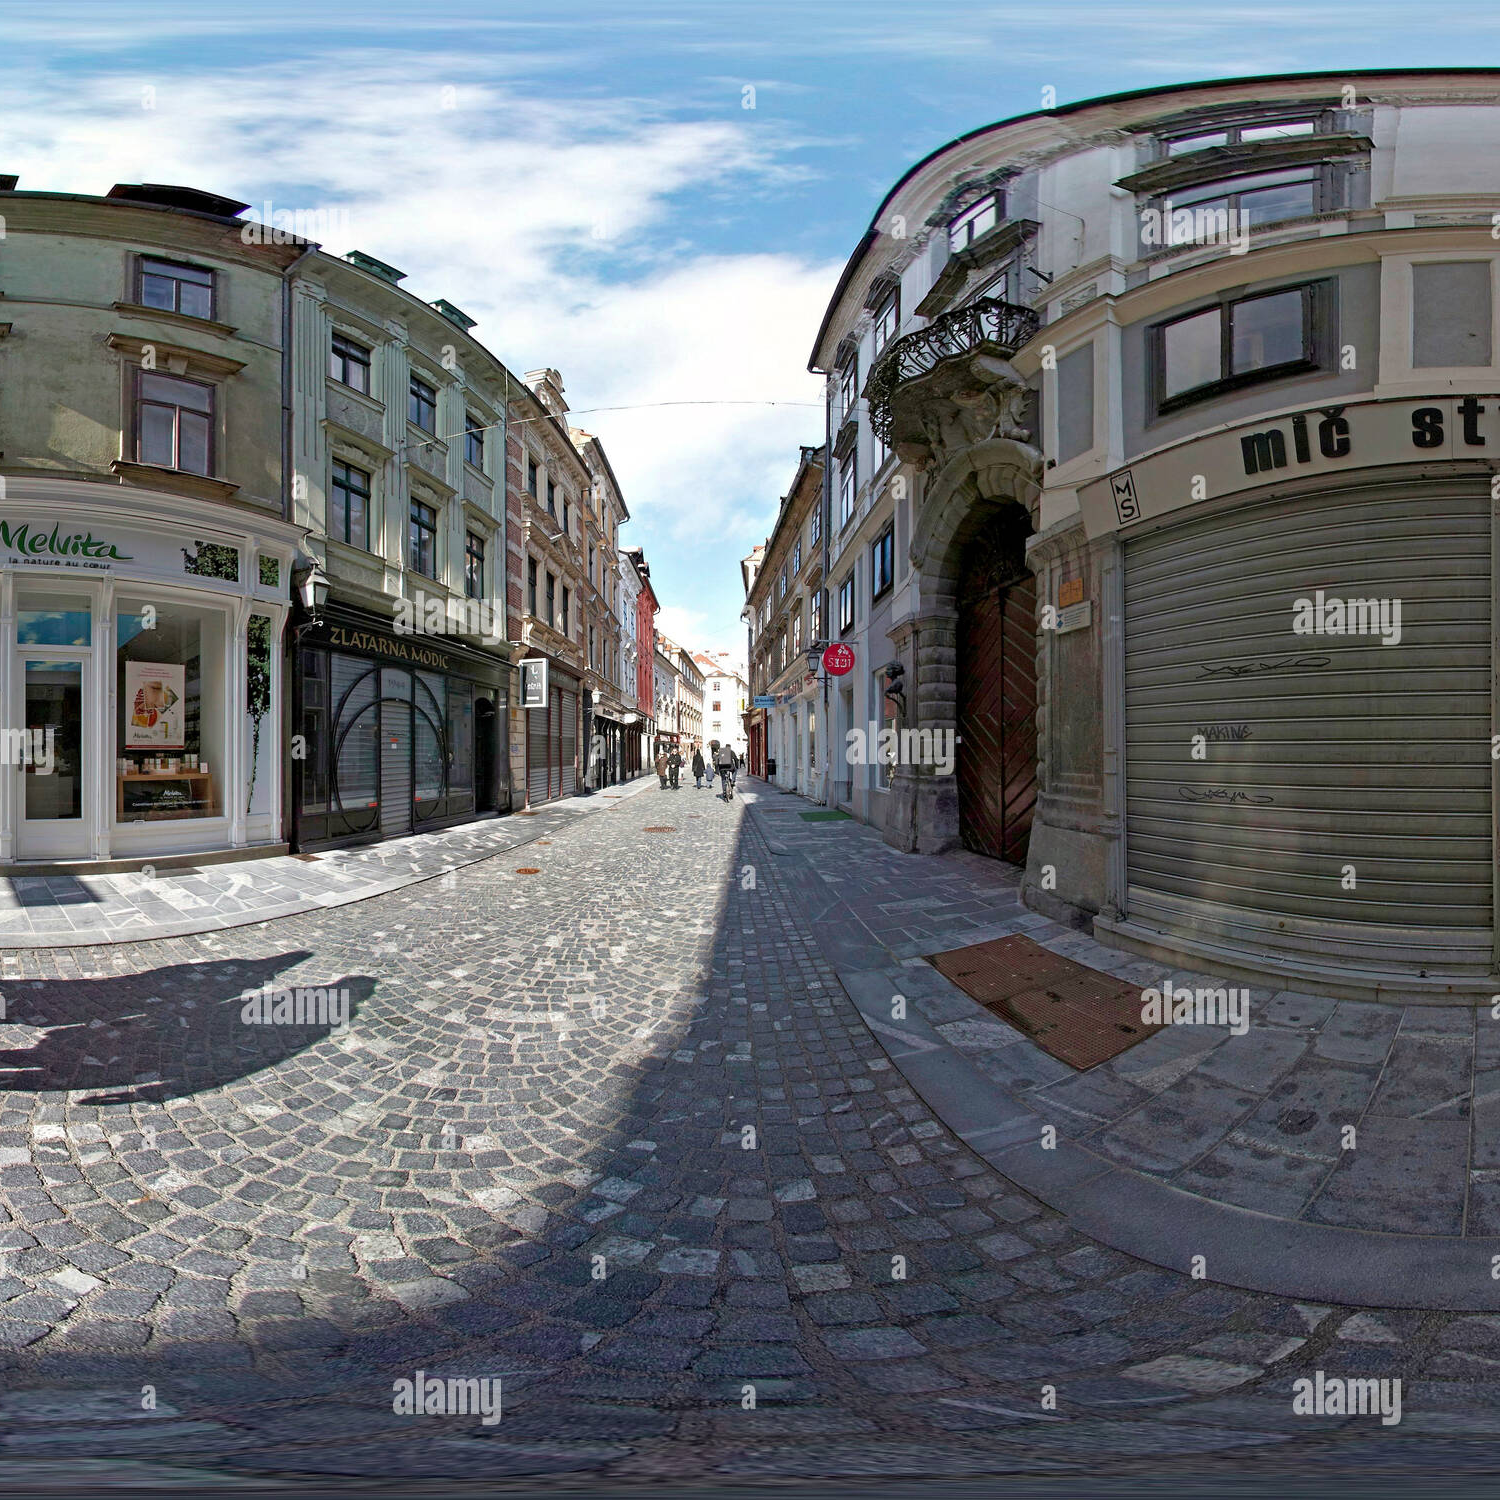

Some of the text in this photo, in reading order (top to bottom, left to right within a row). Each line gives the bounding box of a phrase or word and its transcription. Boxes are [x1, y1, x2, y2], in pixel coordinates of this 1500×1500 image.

[1240, 407, 1350, 475] mič
[8, 556, 18, 565] la
[23, 557, 60, 567] nature
[65, 559, 78, 568] au
[330, 626, 449, 669] ZLATARNA MODIC
